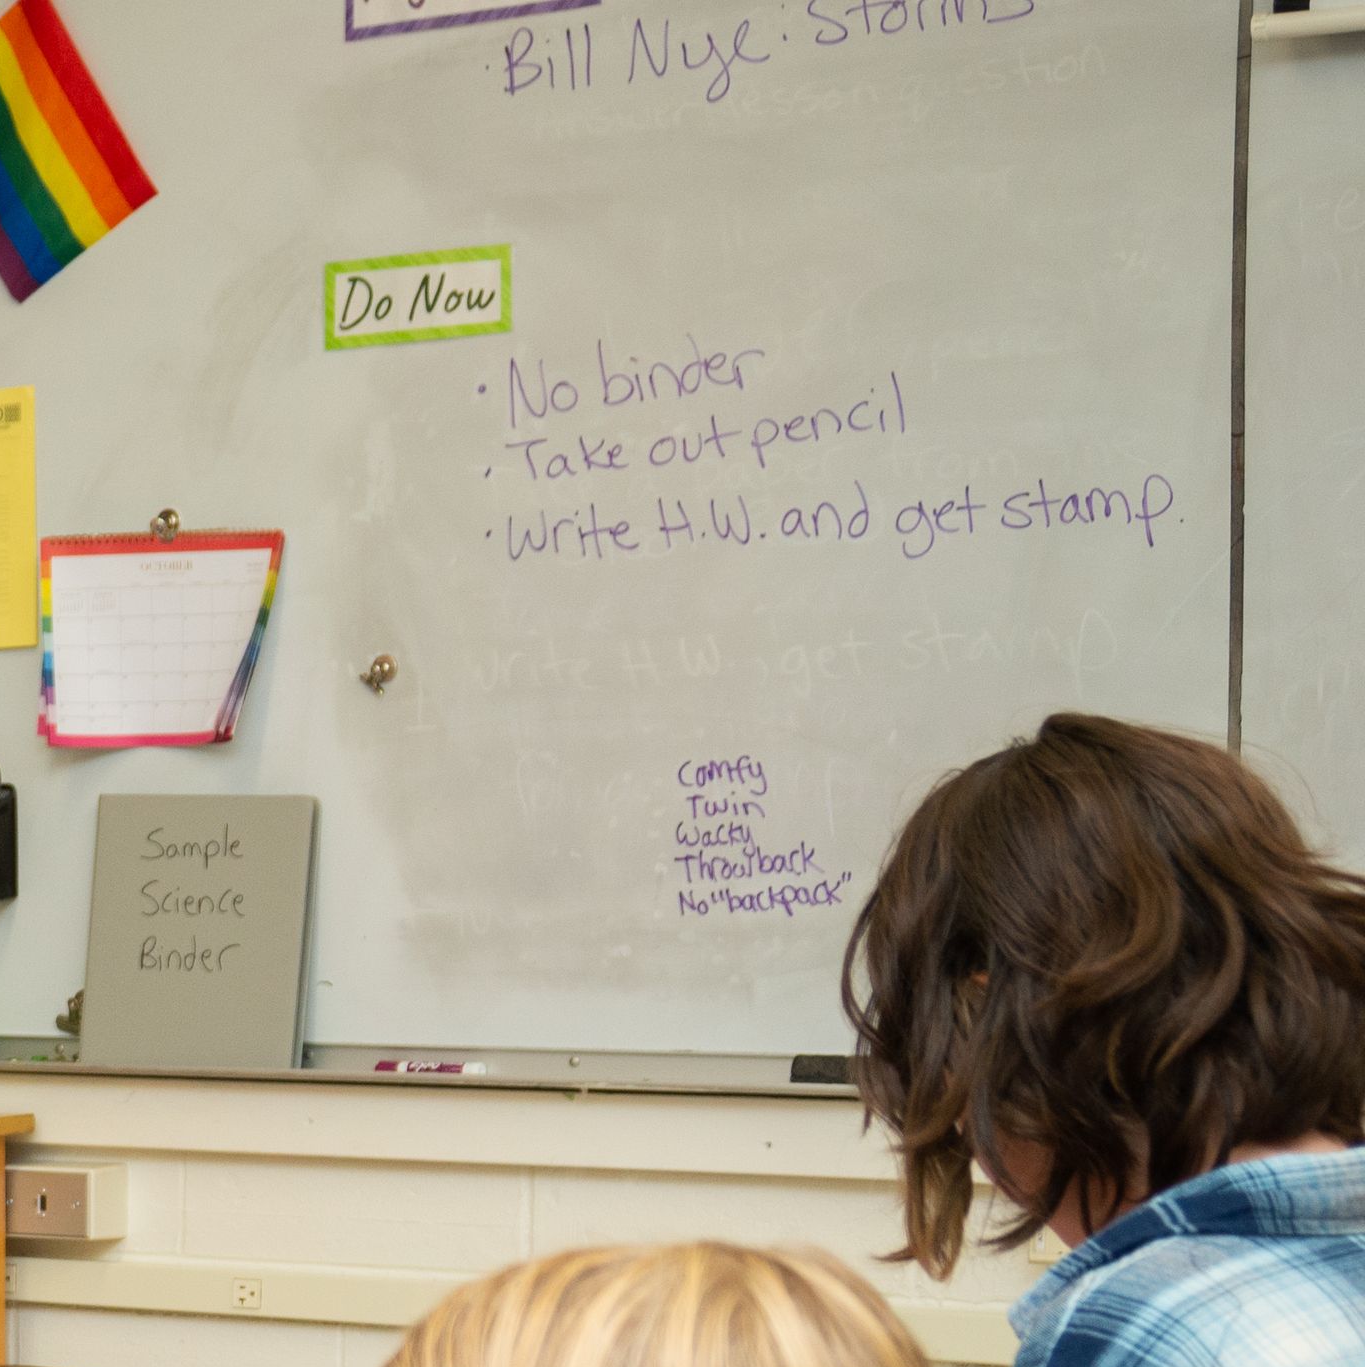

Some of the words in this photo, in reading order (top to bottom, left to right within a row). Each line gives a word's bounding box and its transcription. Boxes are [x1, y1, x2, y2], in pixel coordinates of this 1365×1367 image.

[504, 22, 591, 96] Bill
[339, 275, 393, 331] Do
[408, 271, 496, 322] Now
[508, 356, 578, 429] No
[597, 331, 765, 405] binder
[505, 434, 630, 481] Take
[649, 414, 743, 464] out
[751, 370, 906, 469] pencil
[657, 495, 767, 550] H.W.
[780, 479, 870, 539] and
[894, 484, 988, 559] get
[677, 755, 768, 796] Comfy
[685, 790, 766, 819] Twin
[140, 822, 244, 870] Sample
[675, 820, 757, 858] Wacky
[141, 879, 246, 917] Science
[678, 889, 709, 916] No
[140, 934, 242, 973] Binder
